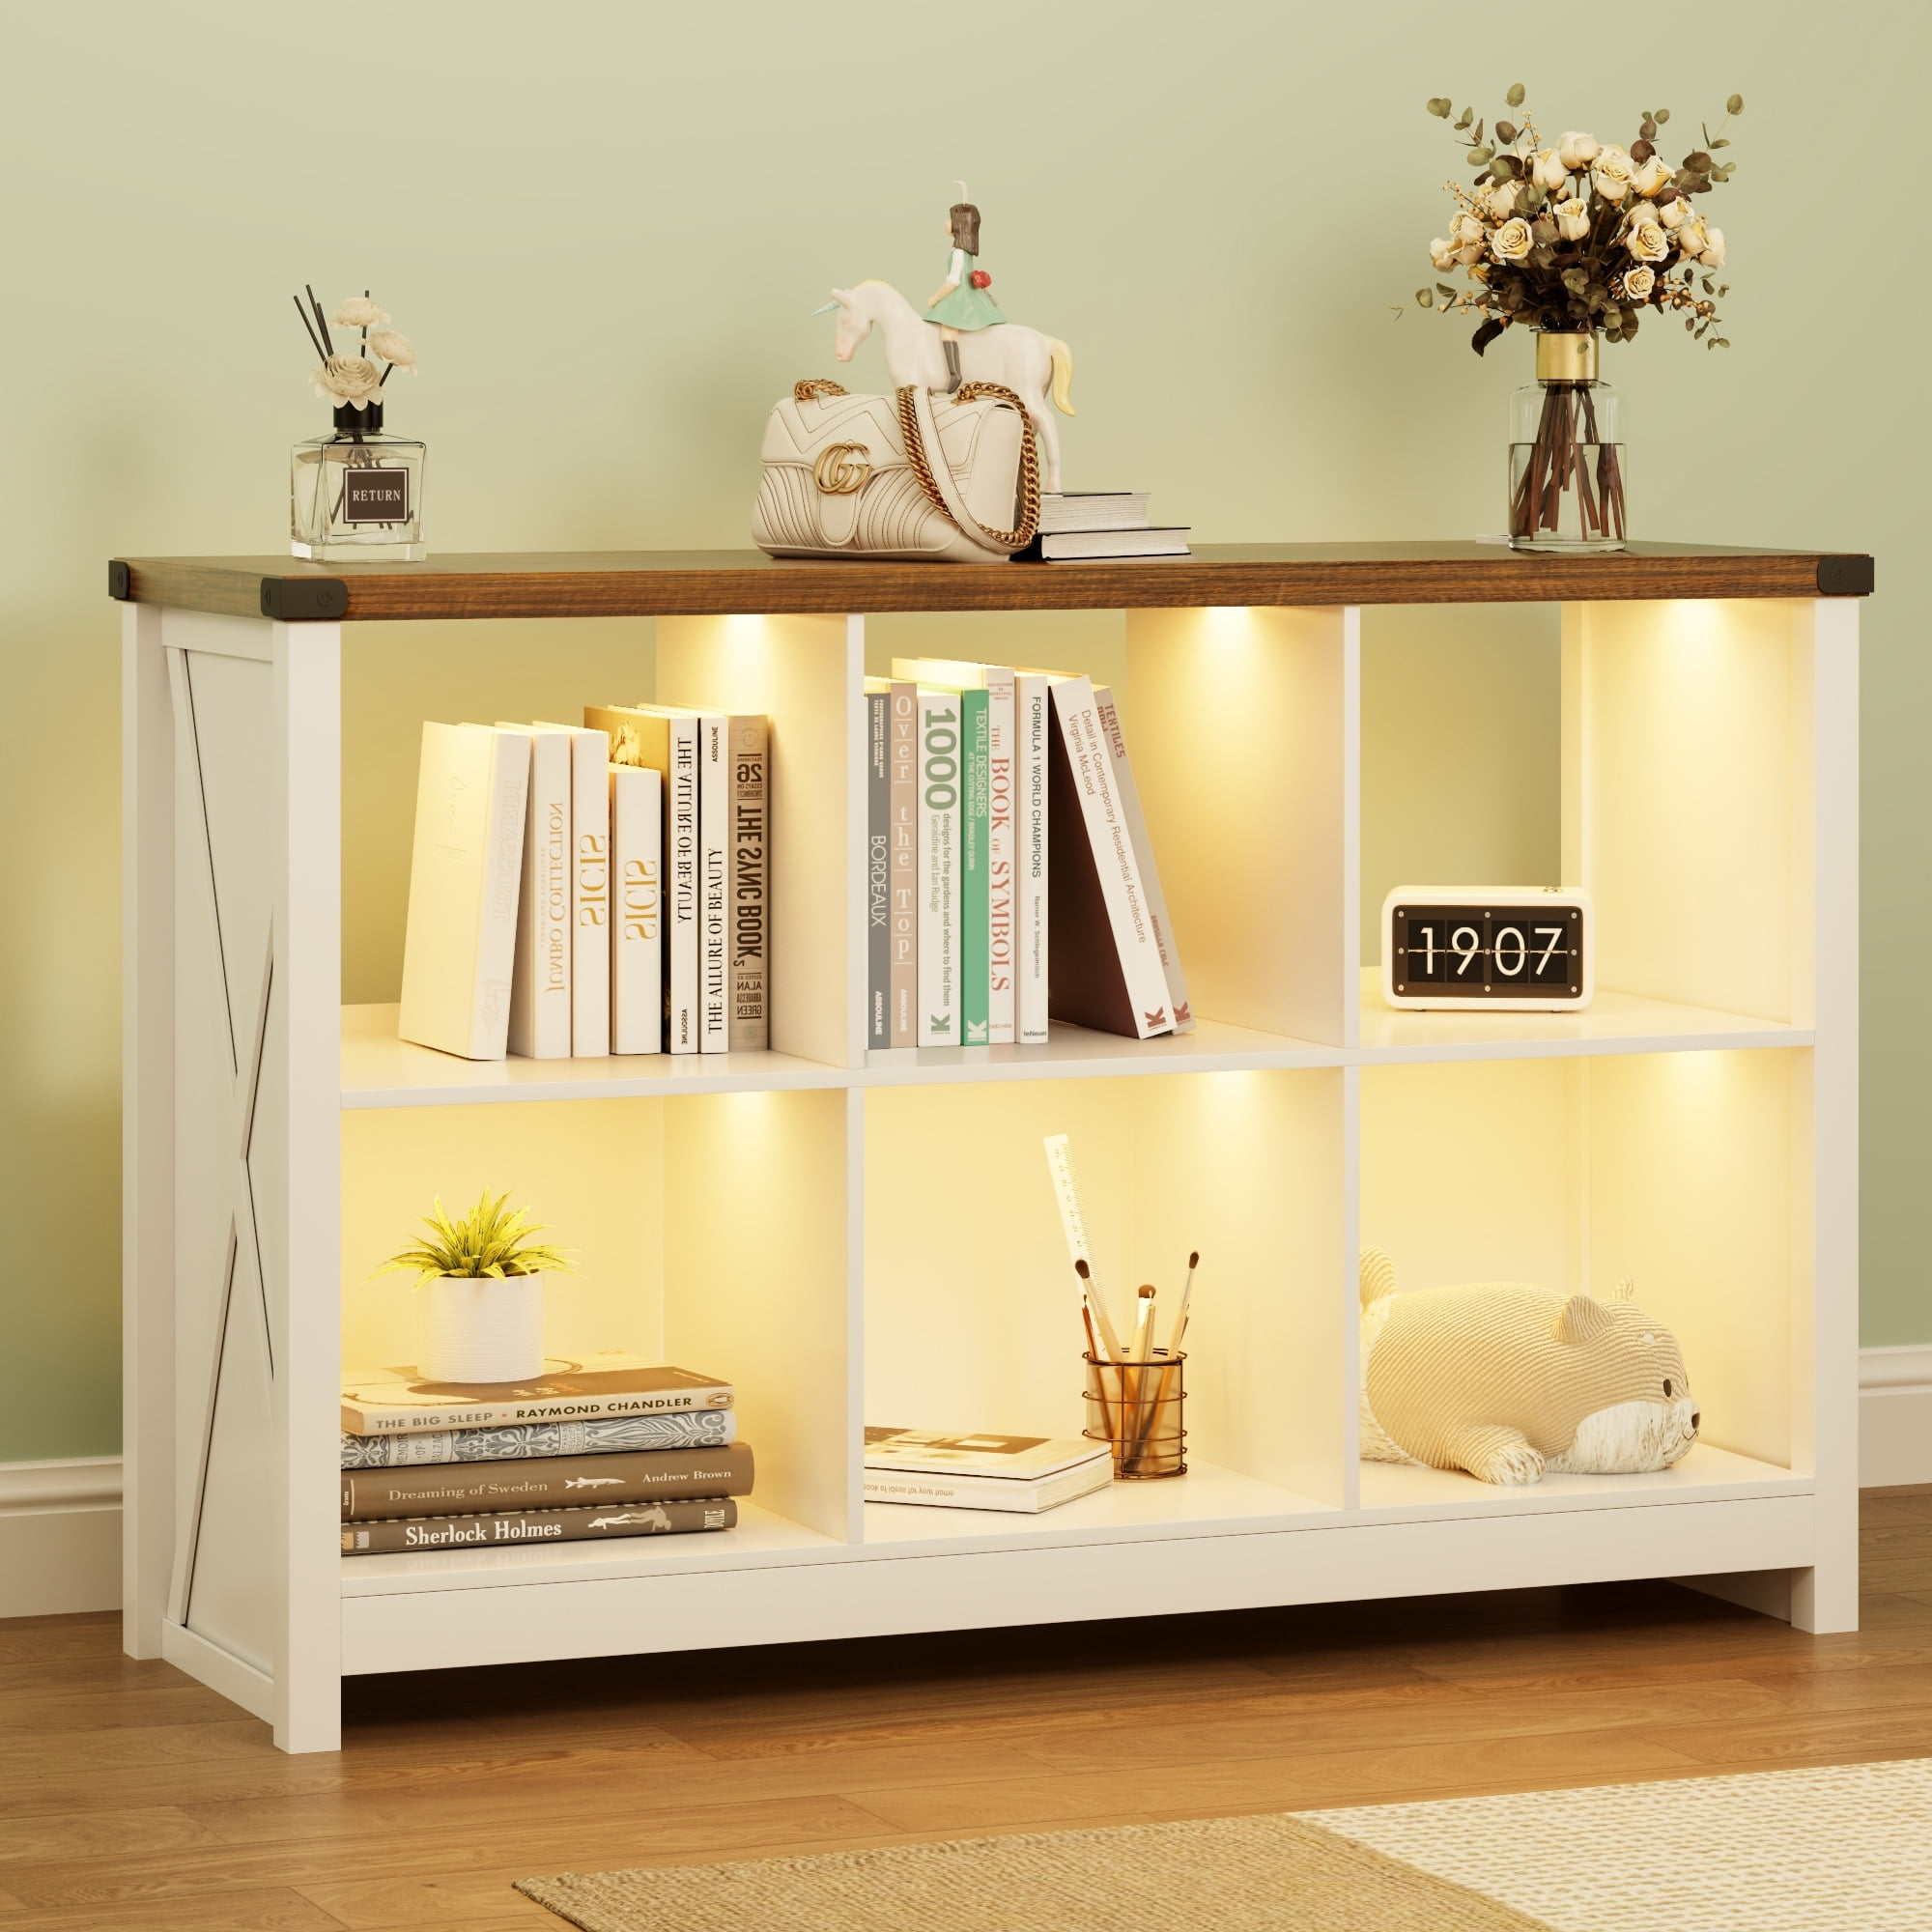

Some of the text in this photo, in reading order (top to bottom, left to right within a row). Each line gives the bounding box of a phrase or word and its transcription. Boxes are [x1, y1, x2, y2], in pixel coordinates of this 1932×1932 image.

[353, 490, 401, 501] RETURN
[1032, 696, 1041, 753] FORMULA
[1068, 714, 1095, 796] Virginia McLeod
[1104, 703, 1126, 758] TEXTILES
[924, 707, 957, 810] 1000
[969, 752, 975, 760] AT
[976, 708, 987, 818] TEXTILE DESIGNERS
[1032, 764, 1041, 807] WORLD
[895, 696, 912, 960] Over the Top
[1032, 810, 1041, 878] CHAMPIONS
[1081, 709, 1146, 944] Detail in Contemporary Residential Architecture
[871, 836, 887, 926] BORDEAUX
[929, 814, 940, 913] Geraldine and Ian Rudge
[991, 725, 1010, 991] THE BOOK OF SYMBOLS
[708, 848, 723, 1034] THE ALLURE OF BEAUTY
[941, 813, 952, 1007] designs for the gardens and where to find them
[376, 1412, 493, 1429] THE BIG SLEEP
[516, 1397, 693, 1419] RAYMOND CHANDLER
[388, 1481, 549, 1501] Dreaming of Sweden
[641, 1469, 732, 1484] Andrew Brown
[406, 1519, 562, 1546] Sherlock Holmes
[703, 1509, 725, 1529] DOYLE
